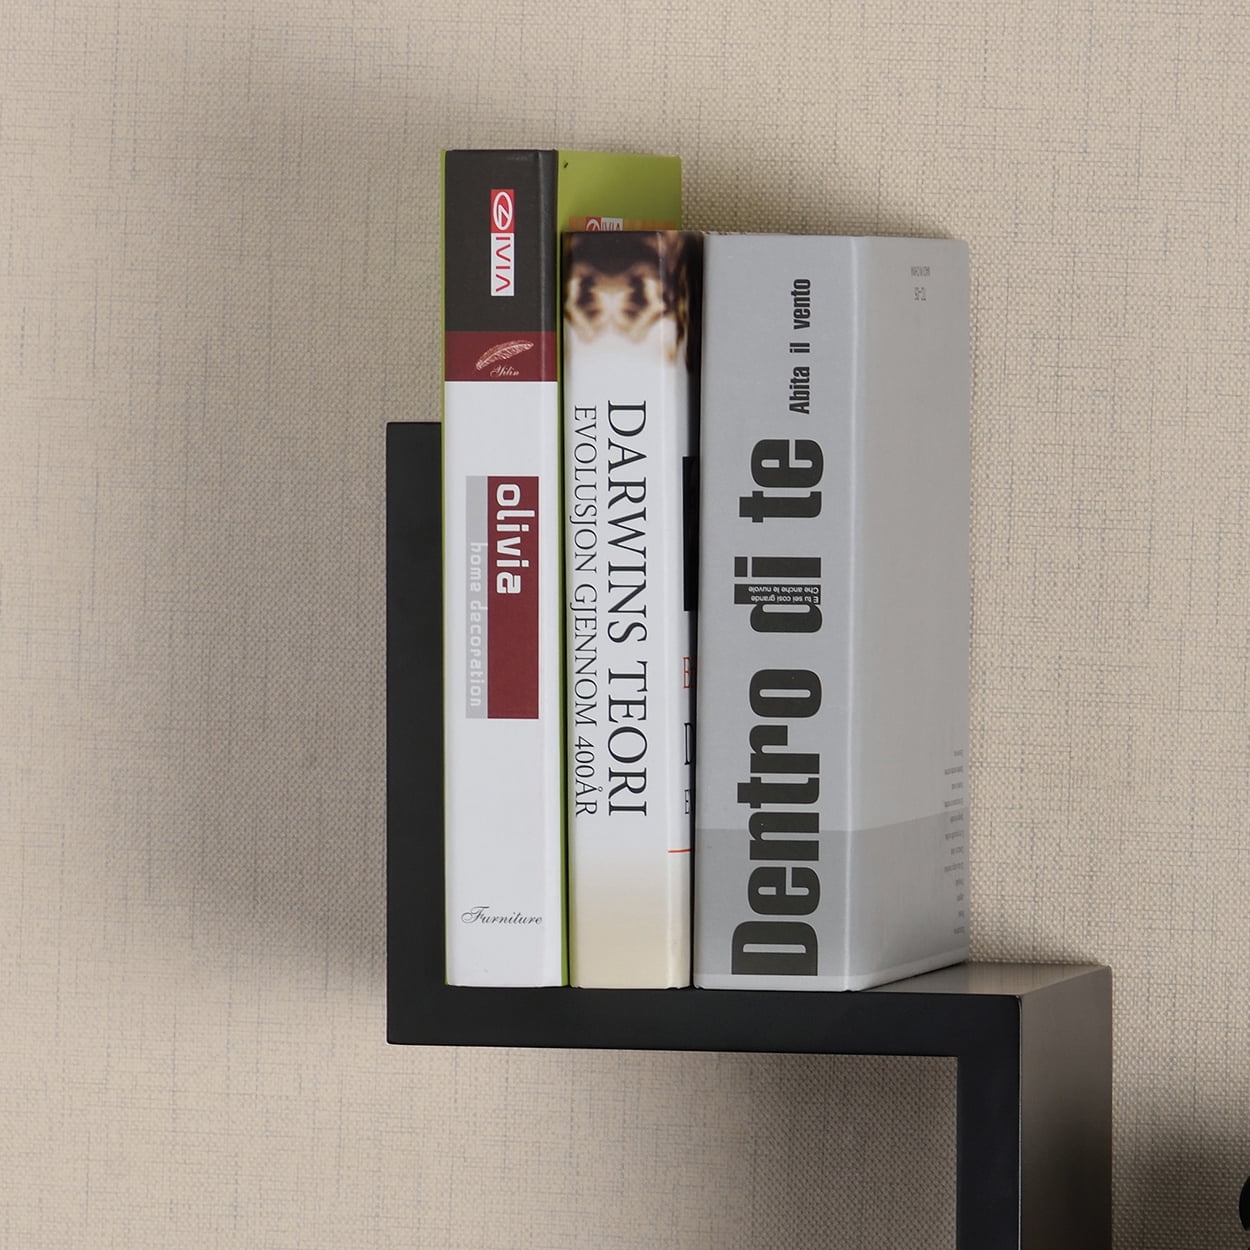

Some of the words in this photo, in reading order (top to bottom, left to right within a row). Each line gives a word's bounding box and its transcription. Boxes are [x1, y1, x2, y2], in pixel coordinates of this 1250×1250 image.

[790, 278, 811, 330] vento
[789, 342, 810, 354] il
[789, 366, 810, 415] Abita
[570, 405, 598, 573] EVOLUSJON
[607, 400, 648, 643] DARWINS
[739, 439, 824, 523] te
[470, 542, 489, 593] home
[496, 483, 535, 594] olivia
[733, 556, 823, 634] di
[570, 583, 598, 727] GJENNOM
[607, 661, 649, 817] TEORI
[731, 669, 822, 976] Dentro
[461, 906, 543, 924] Furniture
